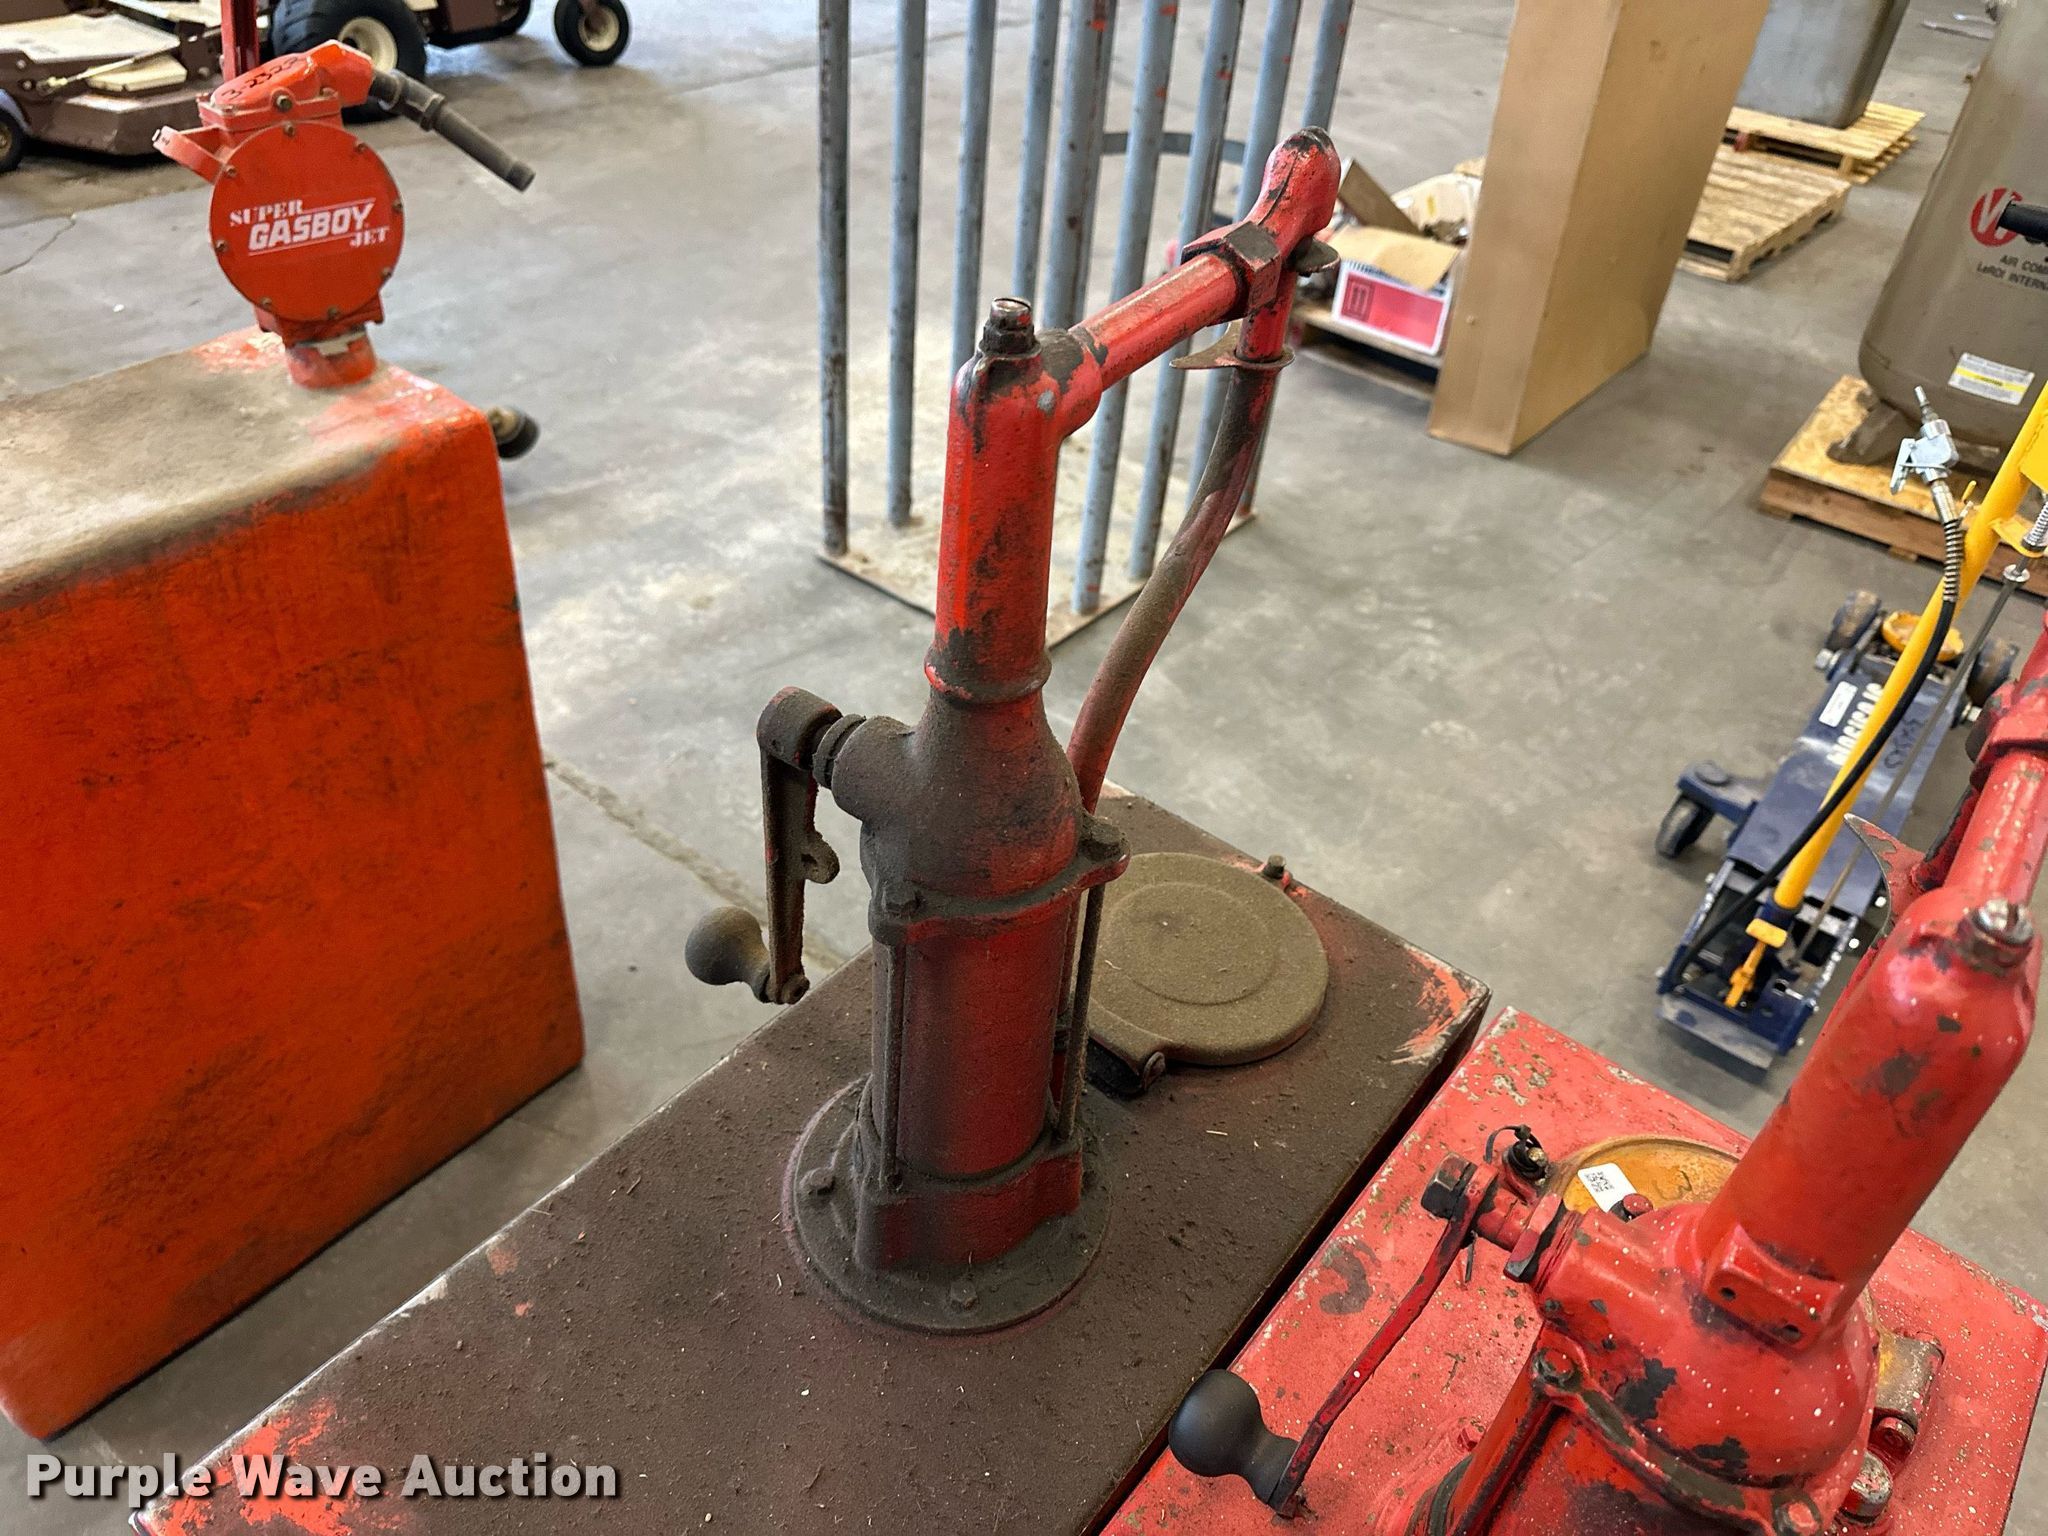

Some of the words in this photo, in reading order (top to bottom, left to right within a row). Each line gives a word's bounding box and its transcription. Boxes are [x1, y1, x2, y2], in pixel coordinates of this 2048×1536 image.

[229, 199, 304, 227] SUPER
[248, 202, 376, 251] GASBOY
[349, 226, 391, 248] JET
[2000, 254, 2019, 268] AIR
[2008, 272, 2048, 291] INTERN
